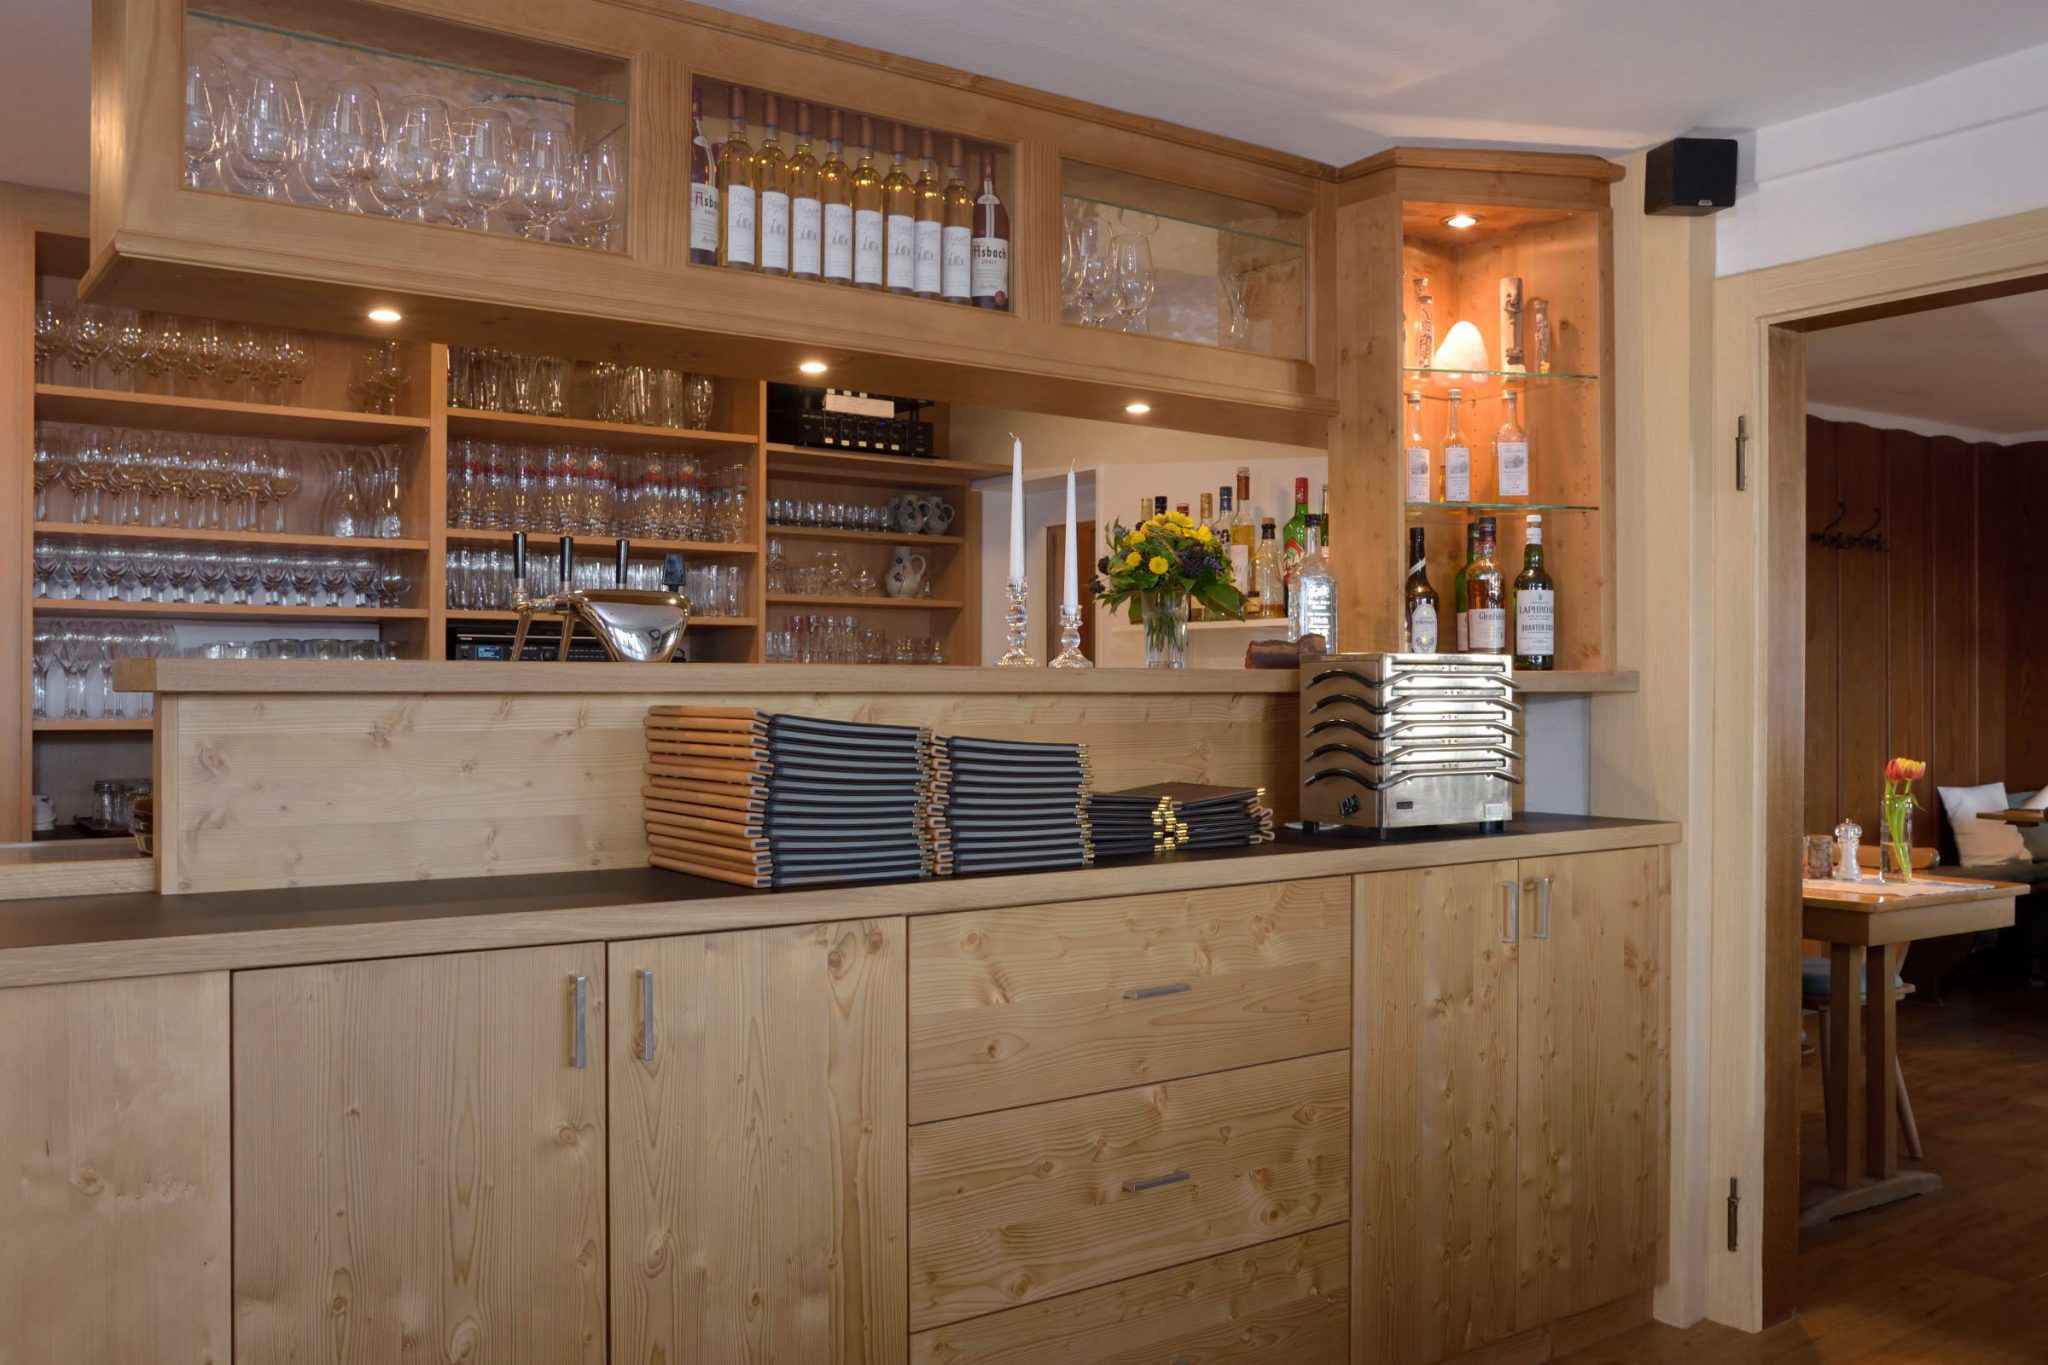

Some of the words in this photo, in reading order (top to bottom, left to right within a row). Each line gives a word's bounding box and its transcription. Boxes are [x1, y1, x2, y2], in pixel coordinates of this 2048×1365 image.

[695, 191, 718, 210] Asba
[971, 244, 1006, 259] Asbach
[1478, 611, 1505, 621] Glenfidd
[1519, 605, 1553, 615] LAPHROA
